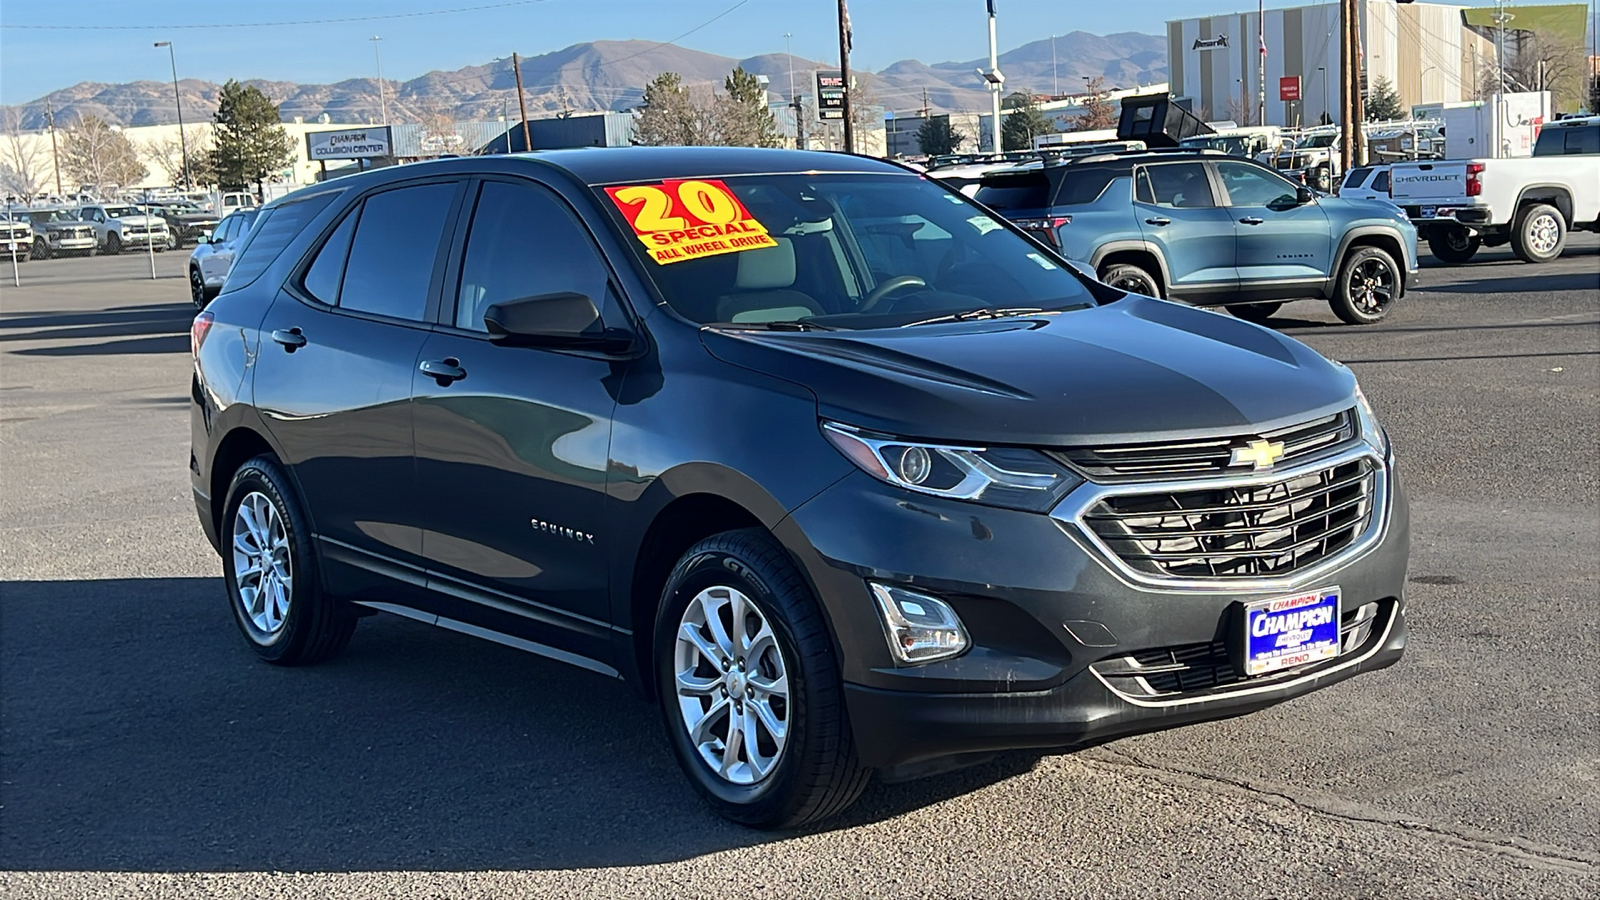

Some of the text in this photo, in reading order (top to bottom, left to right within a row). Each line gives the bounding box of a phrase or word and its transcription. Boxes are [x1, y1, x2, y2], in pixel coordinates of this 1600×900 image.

[330, 133, 367, 146] CHAMPION
[315, 144, 383, 155] COLLISION CENTER
[1395, 174, 1460, 183] CHEVROLET
[614, 180, 743, 232] 20
[651, 221, 757, 246] SPECIAL
[656, 234, 770, 261] ALL WHEEL DRIVE
[531, 518, 594, 545] EQUINOX
[1272, 594, 1317, 611] CHAMPION
[1252, 605, 1333, 637] CHAMPION
[1279, 632, 1310, 642] CHEVROLET
[1281, 653, 1310, 666] RENO
